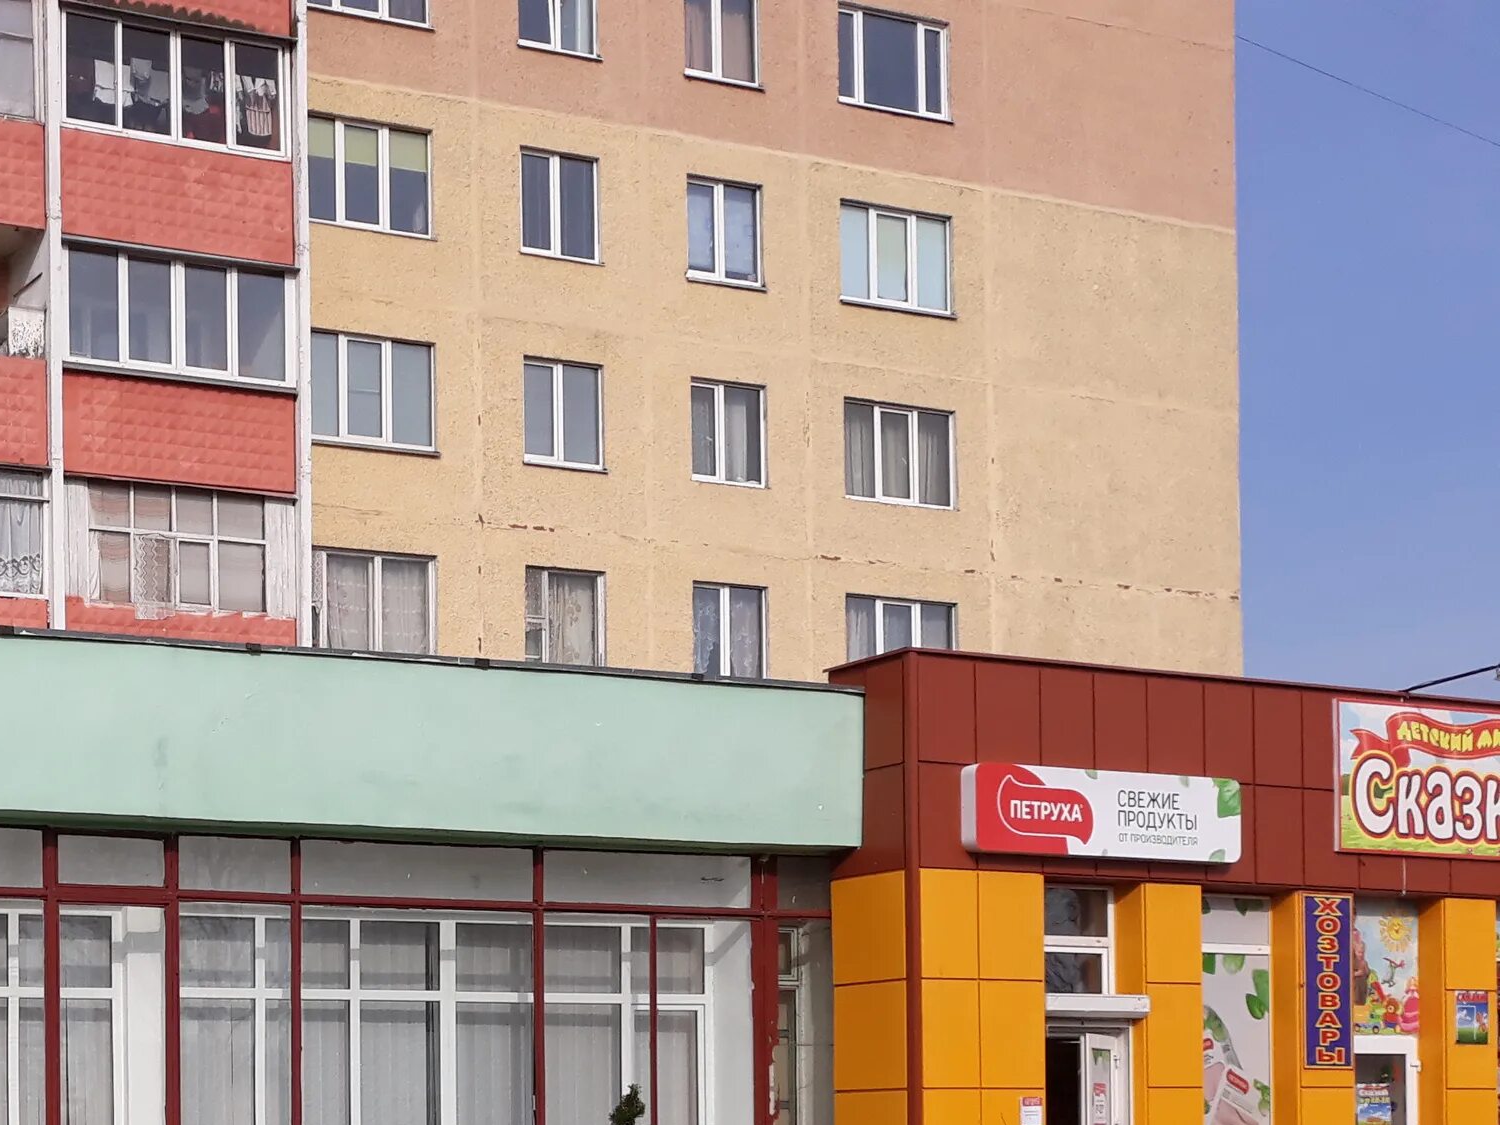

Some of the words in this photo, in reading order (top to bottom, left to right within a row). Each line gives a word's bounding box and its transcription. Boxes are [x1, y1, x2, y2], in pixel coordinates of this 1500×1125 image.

[1396, 720, 1474, 753] ДЕТСКИЙ
[1009, 799, 1084, 823] ПЕТРУХА
[1117, 789, 1181, 811] СВЕЖИЕ
[1117, 809, 1198, 832] ПРОДУКТЫ
[1118, 832, 1128, 843] ОТ
[1130, 833, 1199, 847] ПРОИЗВОДИТЕЛЯ
[1313, 897, 1346, 1065] ХОЗТОВАРЫ
